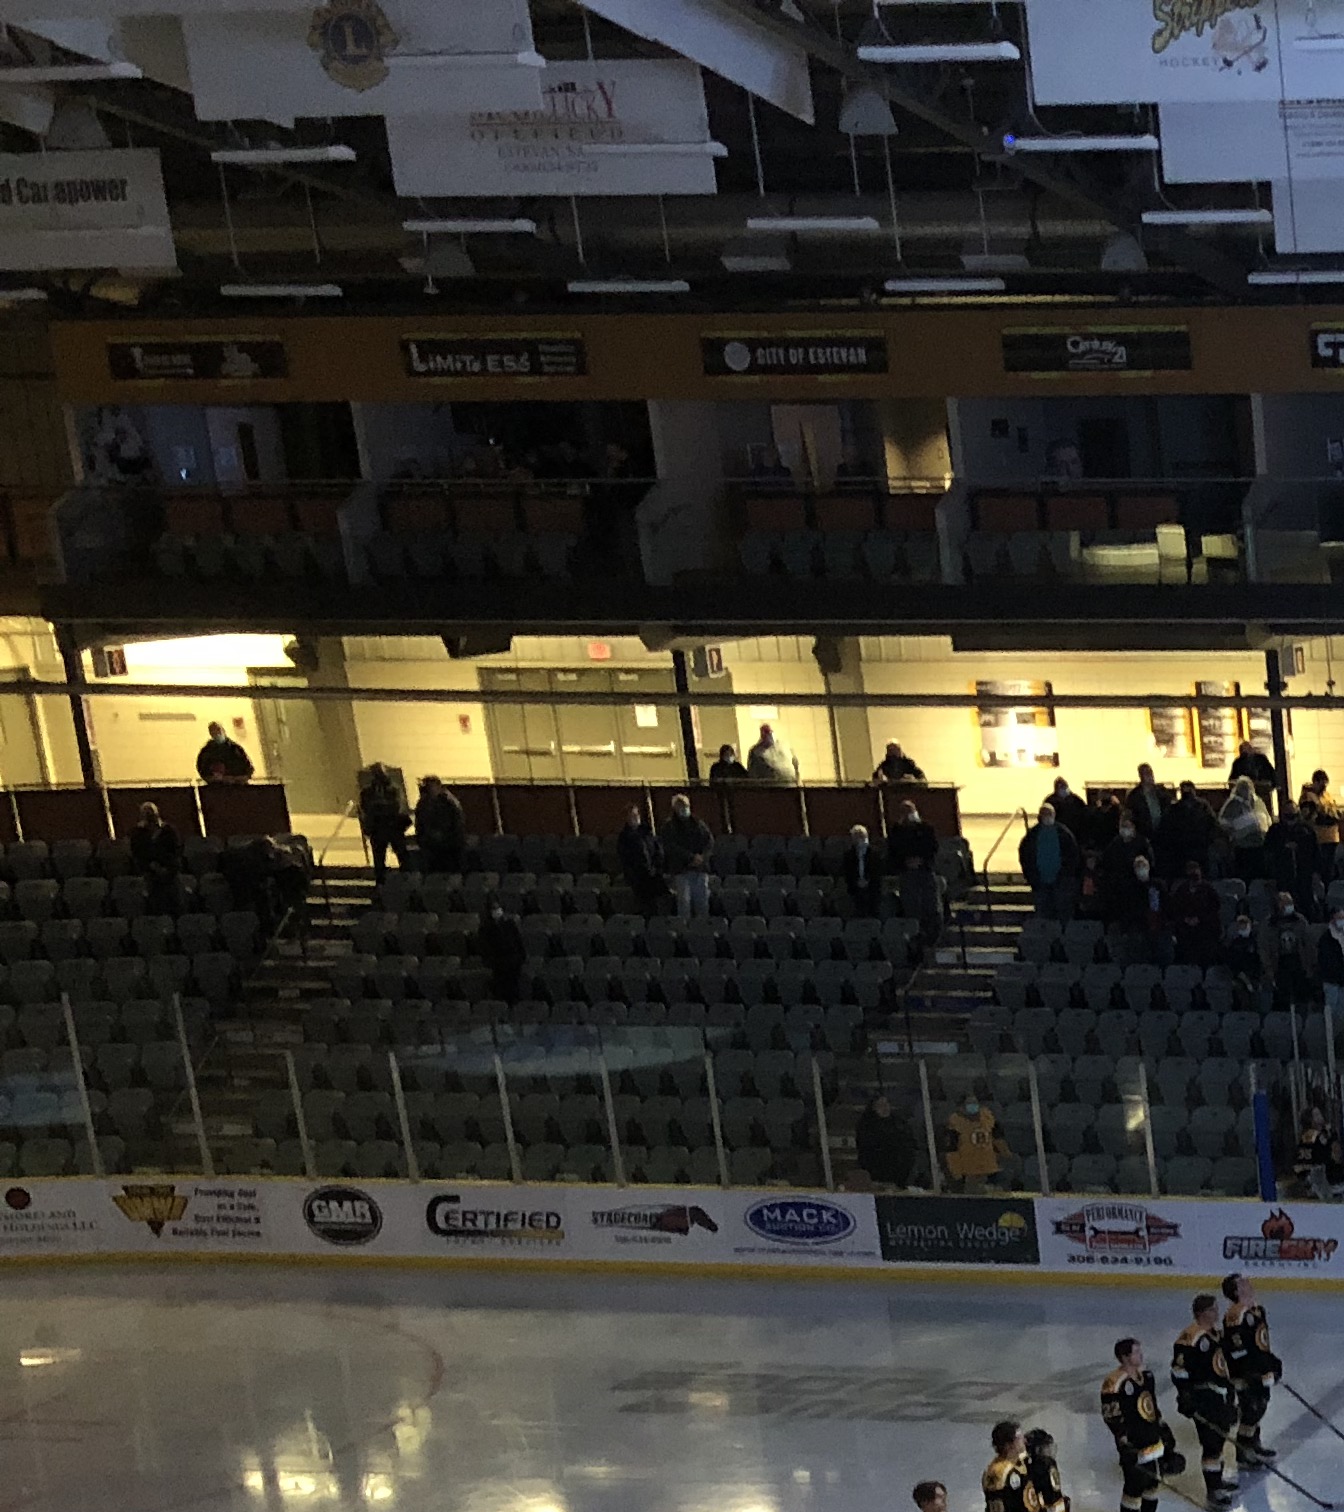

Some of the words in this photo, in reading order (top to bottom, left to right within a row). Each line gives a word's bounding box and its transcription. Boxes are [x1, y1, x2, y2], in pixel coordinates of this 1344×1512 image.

[809, 345, 867, 365] ESTEVAN
[426, 1195, 562, 1235] CERTIFIED
[761, 1206, 838, 1224] MACK
[886, 1222, 949, 1240] Lemon
[957, 1221, 1022, 1245] Wedge
